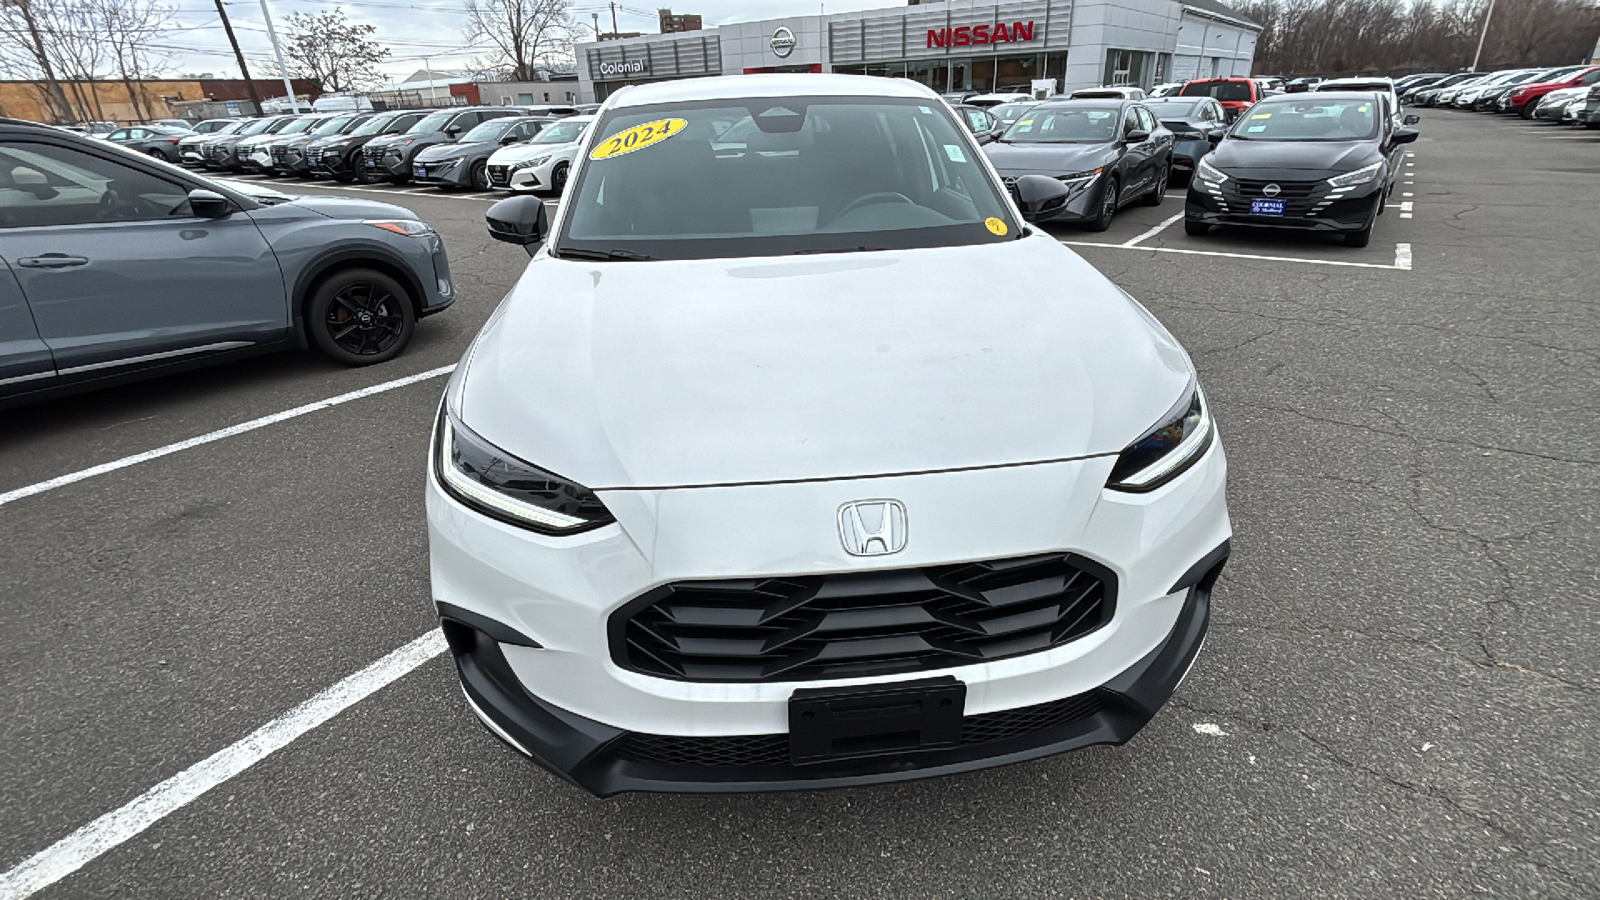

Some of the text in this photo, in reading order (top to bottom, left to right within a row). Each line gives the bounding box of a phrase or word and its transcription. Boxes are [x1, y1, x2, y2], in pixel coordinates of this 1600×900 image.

[926, 20, 1034, 48] NISSAN
[600, 59, 644, 74] Colonial
[608, 120, 671, 155] 2024
